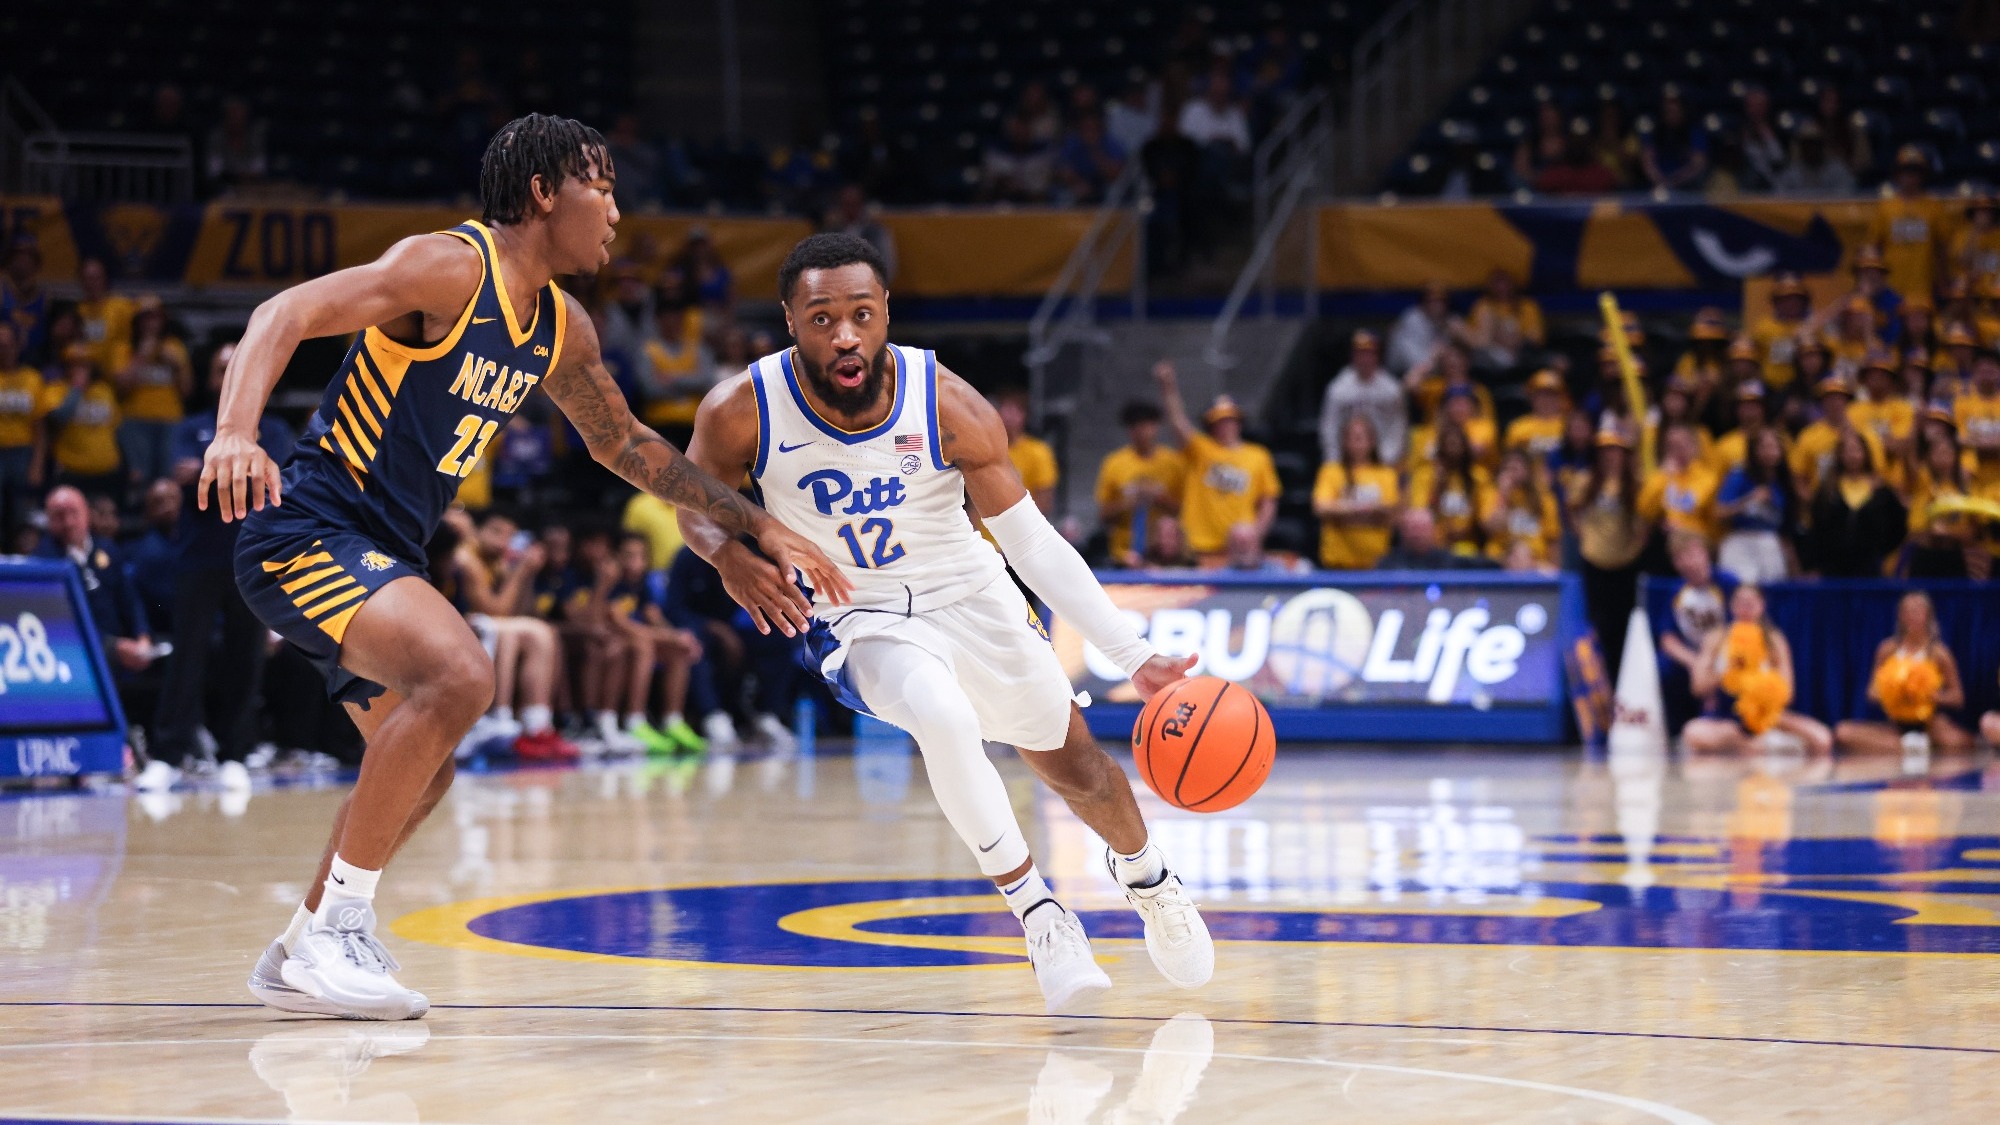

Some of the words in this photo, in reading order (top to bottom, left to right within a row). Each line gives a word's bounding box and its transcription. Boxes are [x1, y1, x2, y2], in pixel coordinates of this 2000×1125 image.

[221, 208, 338, 279] ZOO
[436, 414, 499, 478] 23
[797, 469, 907, 515] Pitt
[836, 517, 907, 569] 12
[1161, 702, 1197, 741] Pitt
[16, 737, 81, 776] UPMC
